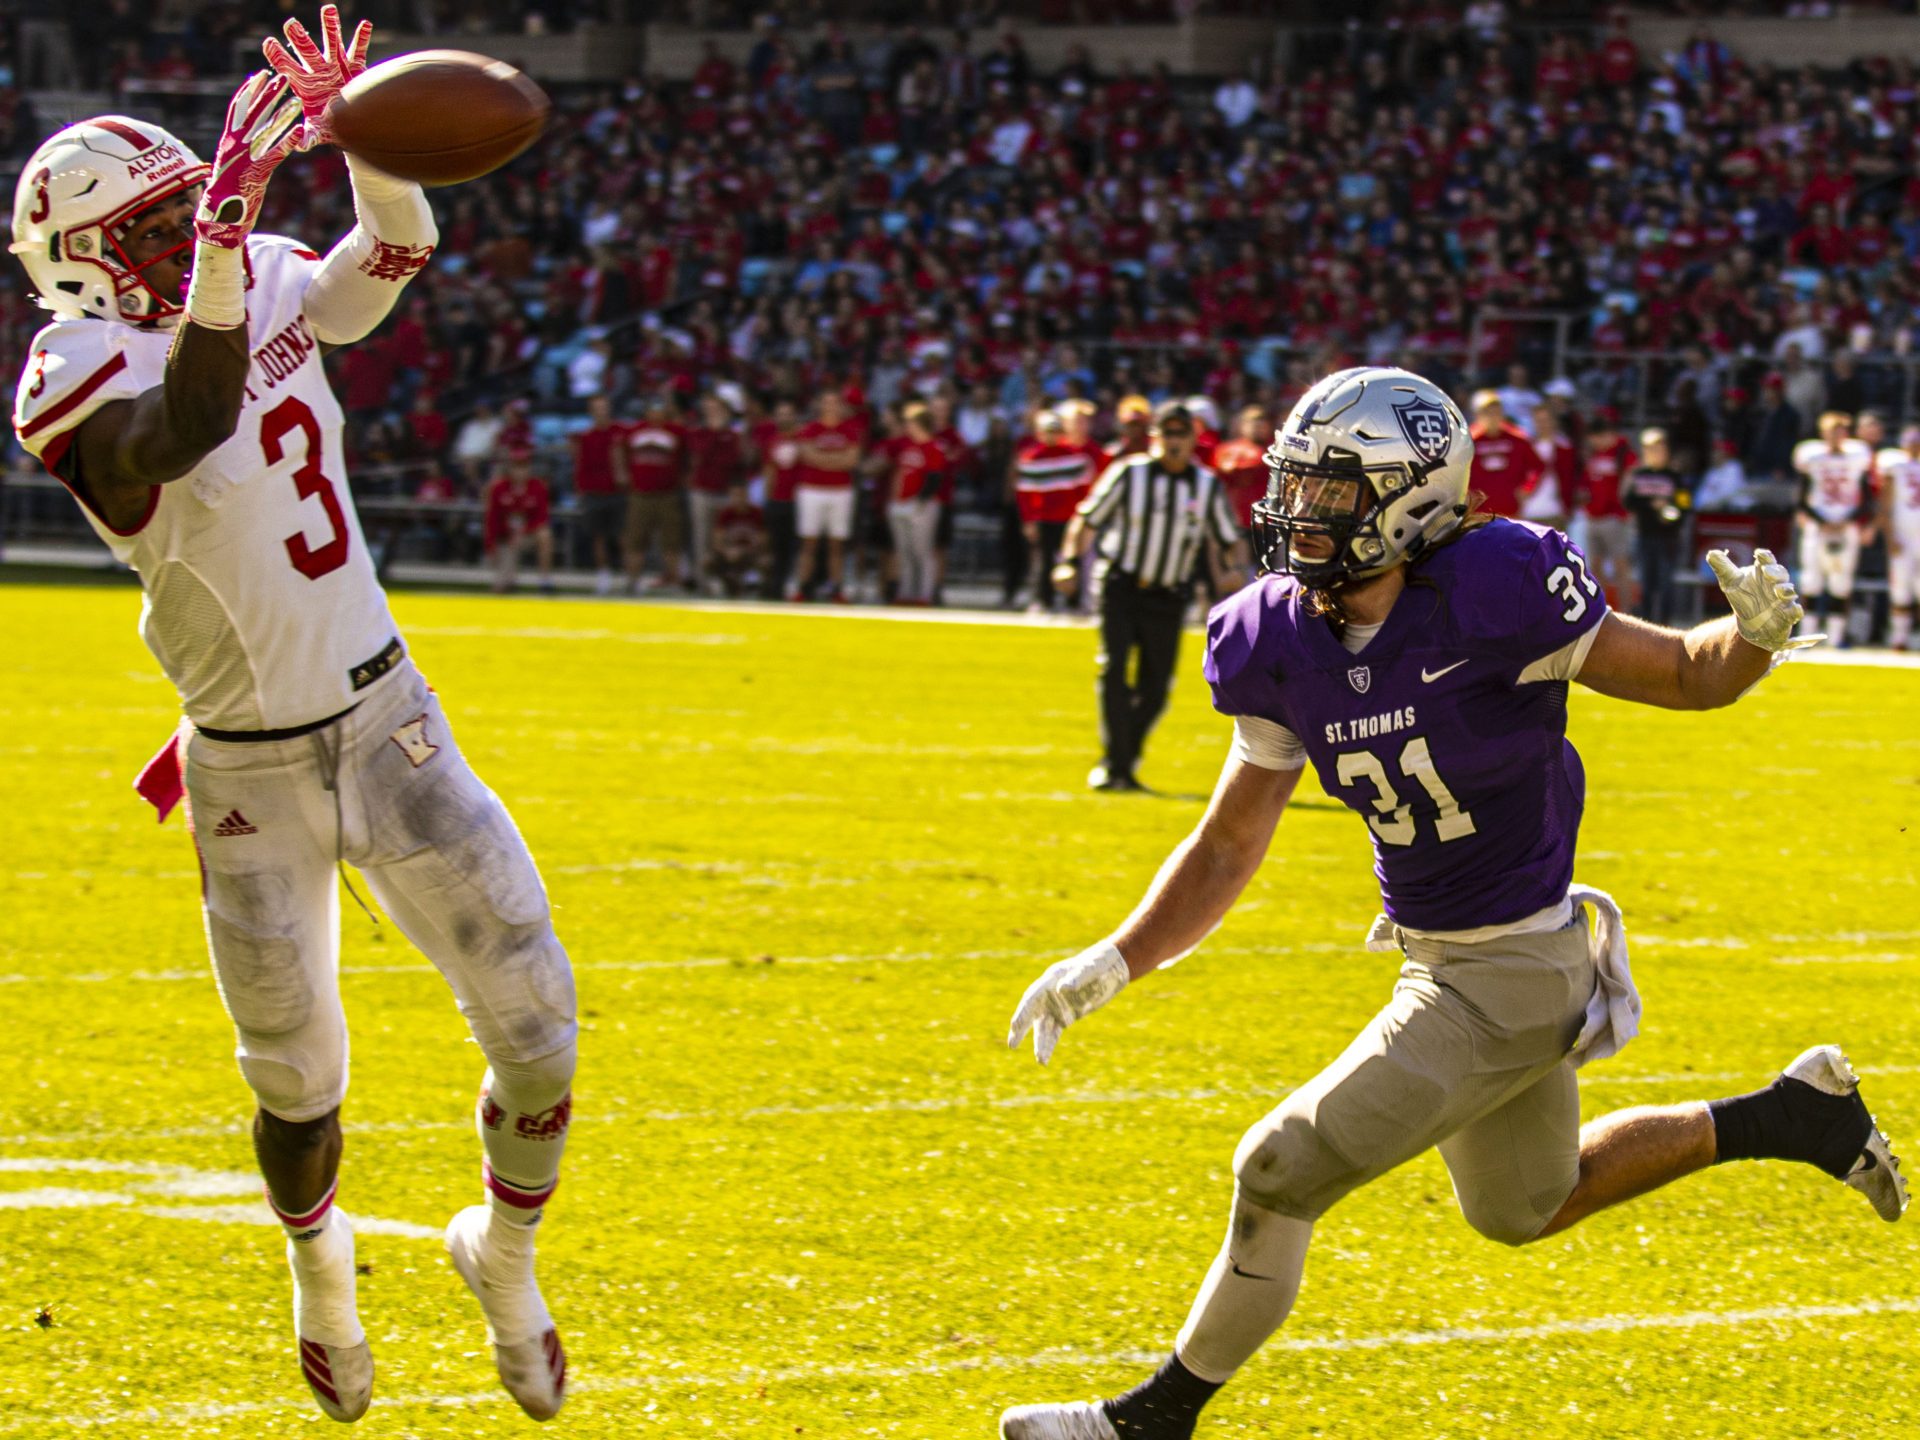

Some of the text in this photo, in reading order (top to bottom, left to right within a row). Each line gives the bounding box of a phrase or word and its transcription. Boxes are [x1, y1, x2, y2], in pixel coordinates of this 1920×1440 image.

[127, 145, 182, 179] ALSTON
[30, 167, 50, 224] 3
[261, 395, 349, 581] 3
[1546, 549, 1599, 624] 31
[1325, 706, 1416, 744] ST. THOMAS
[1336, 737, 1477, 846] 31
